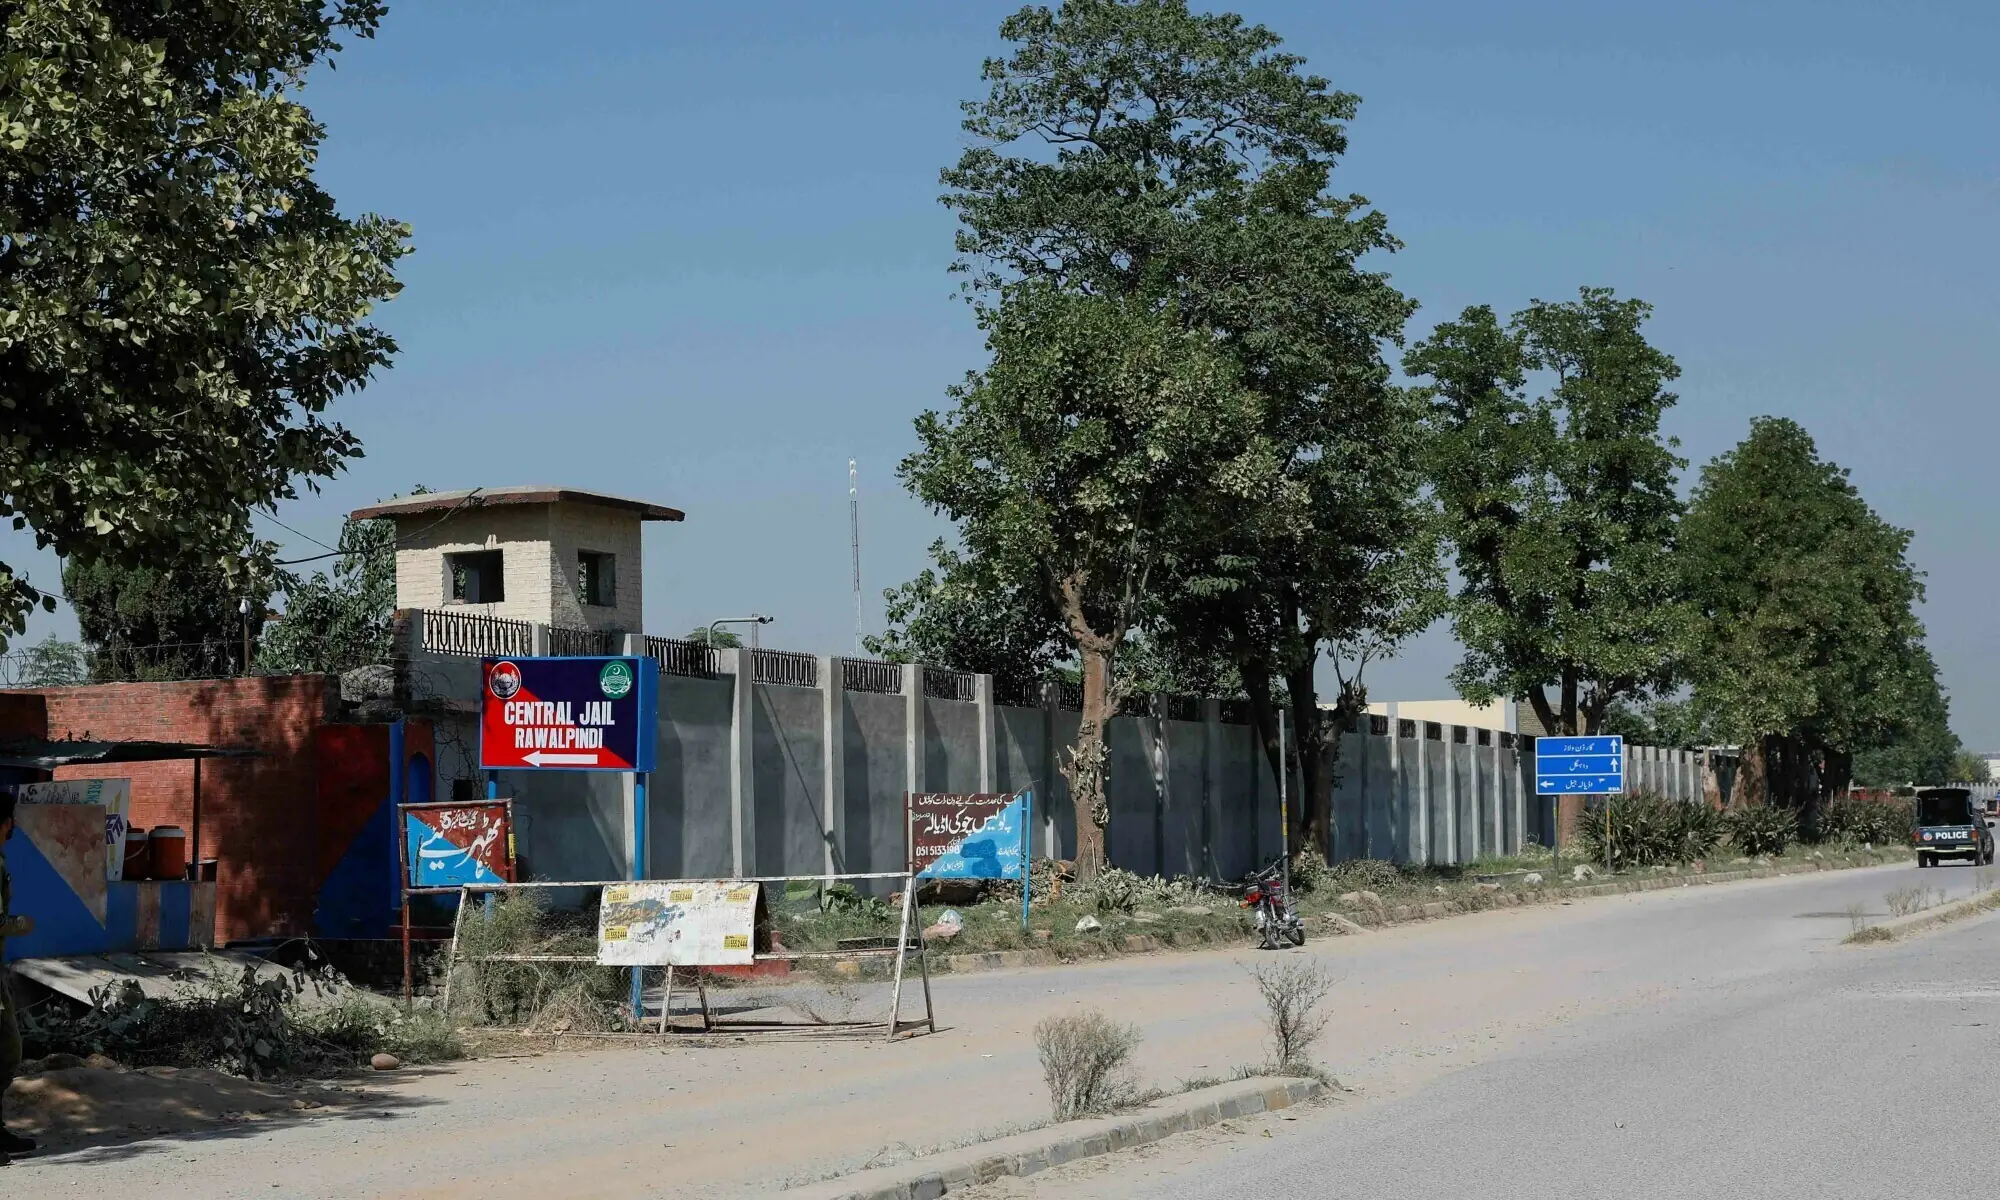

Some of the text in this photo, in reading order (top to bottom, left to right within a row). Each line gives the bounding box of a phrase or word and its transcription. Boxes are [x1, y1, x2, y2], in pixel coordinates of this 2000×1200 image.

[504, 701, 615, 725] CENTRAL JAIL
[515, 728, 603, 749] RAWALPINDI
[924, 812, 949, 836] اڈیالہ
[949, 806, 974, 836] چوکی
[972, 807, 1012, 834] پولیس
[1935, 831, 1968, 839] POLICE
[916, 846, 929, 856] 051
